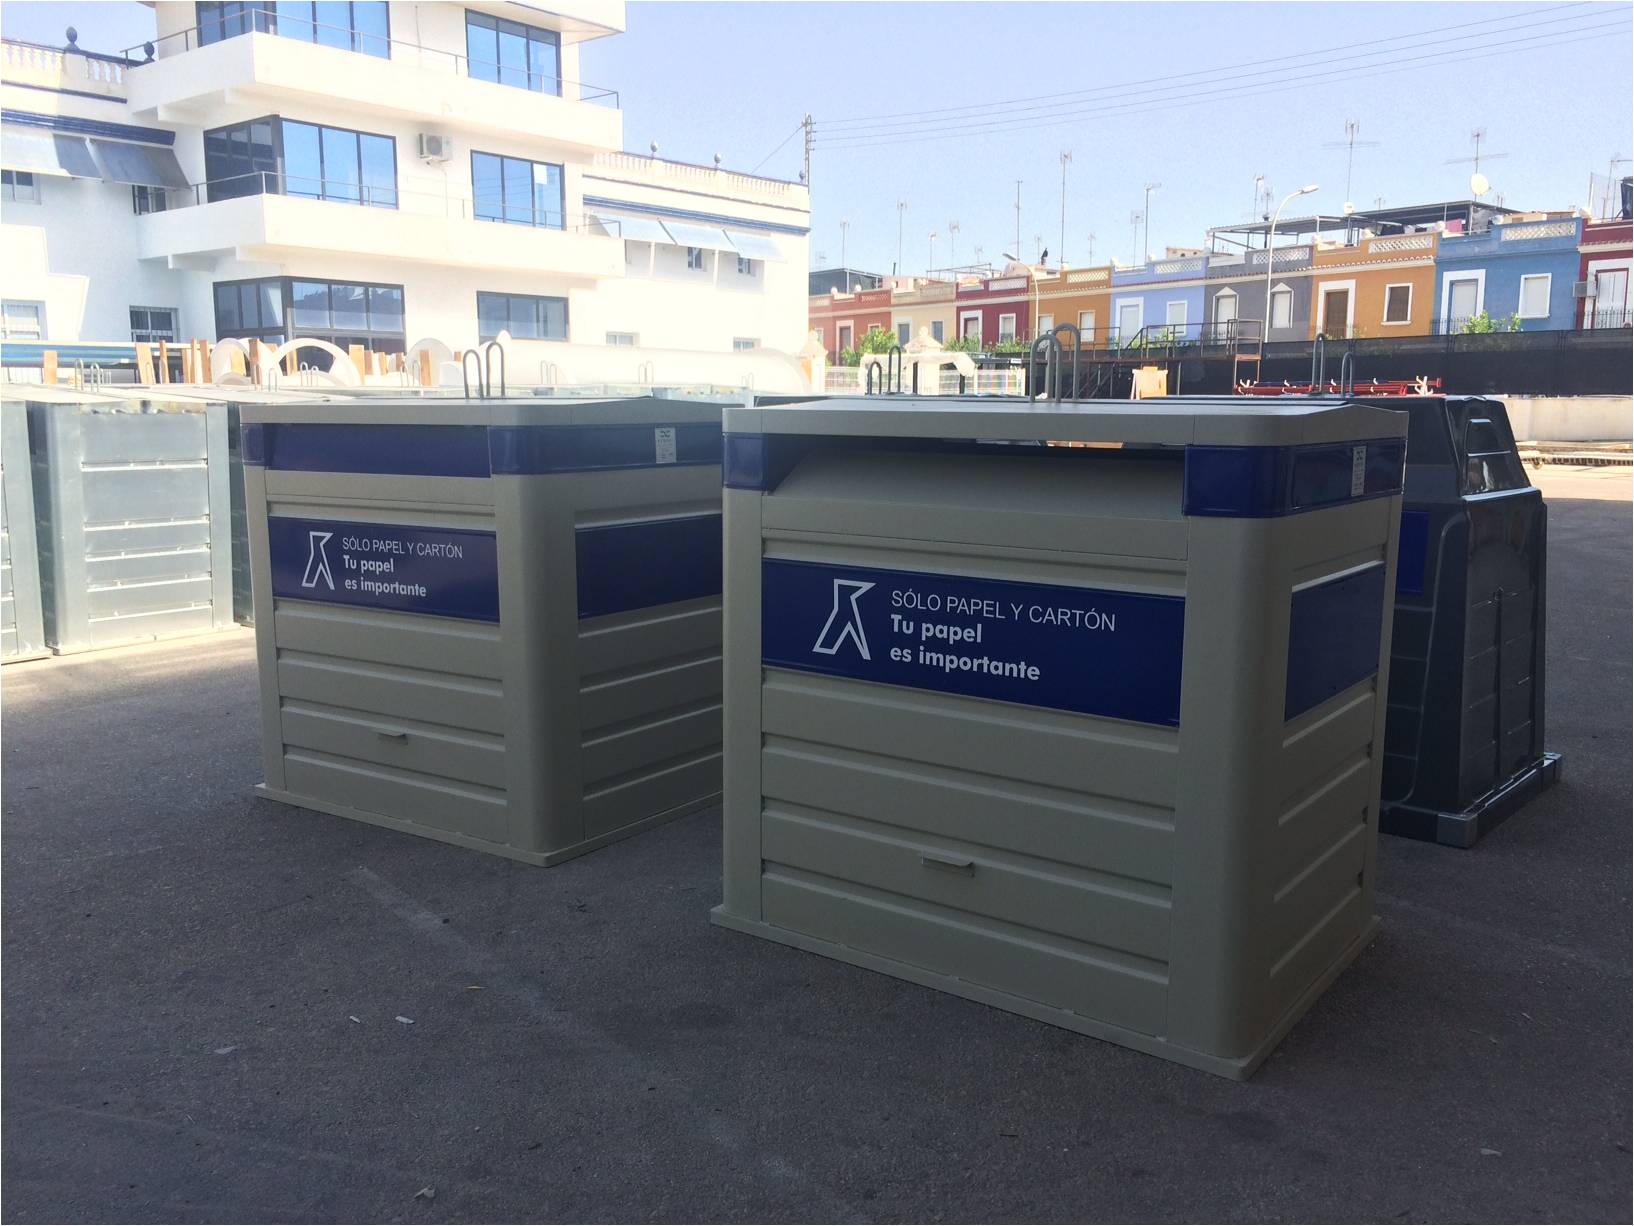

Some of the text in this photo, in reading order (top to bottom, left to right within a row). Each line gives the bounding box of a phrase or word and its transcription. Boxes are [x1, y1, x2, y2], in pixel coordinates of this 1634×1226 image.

[342, 535, 463, 558] SÓLO PAPEL Y CARTÓN
[343, 554, 394, 575] Tu papel
[344, 577, 427, 596] es importante
[891, 588, 1116, 631] SÓLO PAPEL Y CARTÓN
[890, 613, 982, 645] Tu papel
[890, 645, 1041, 681] es importante
